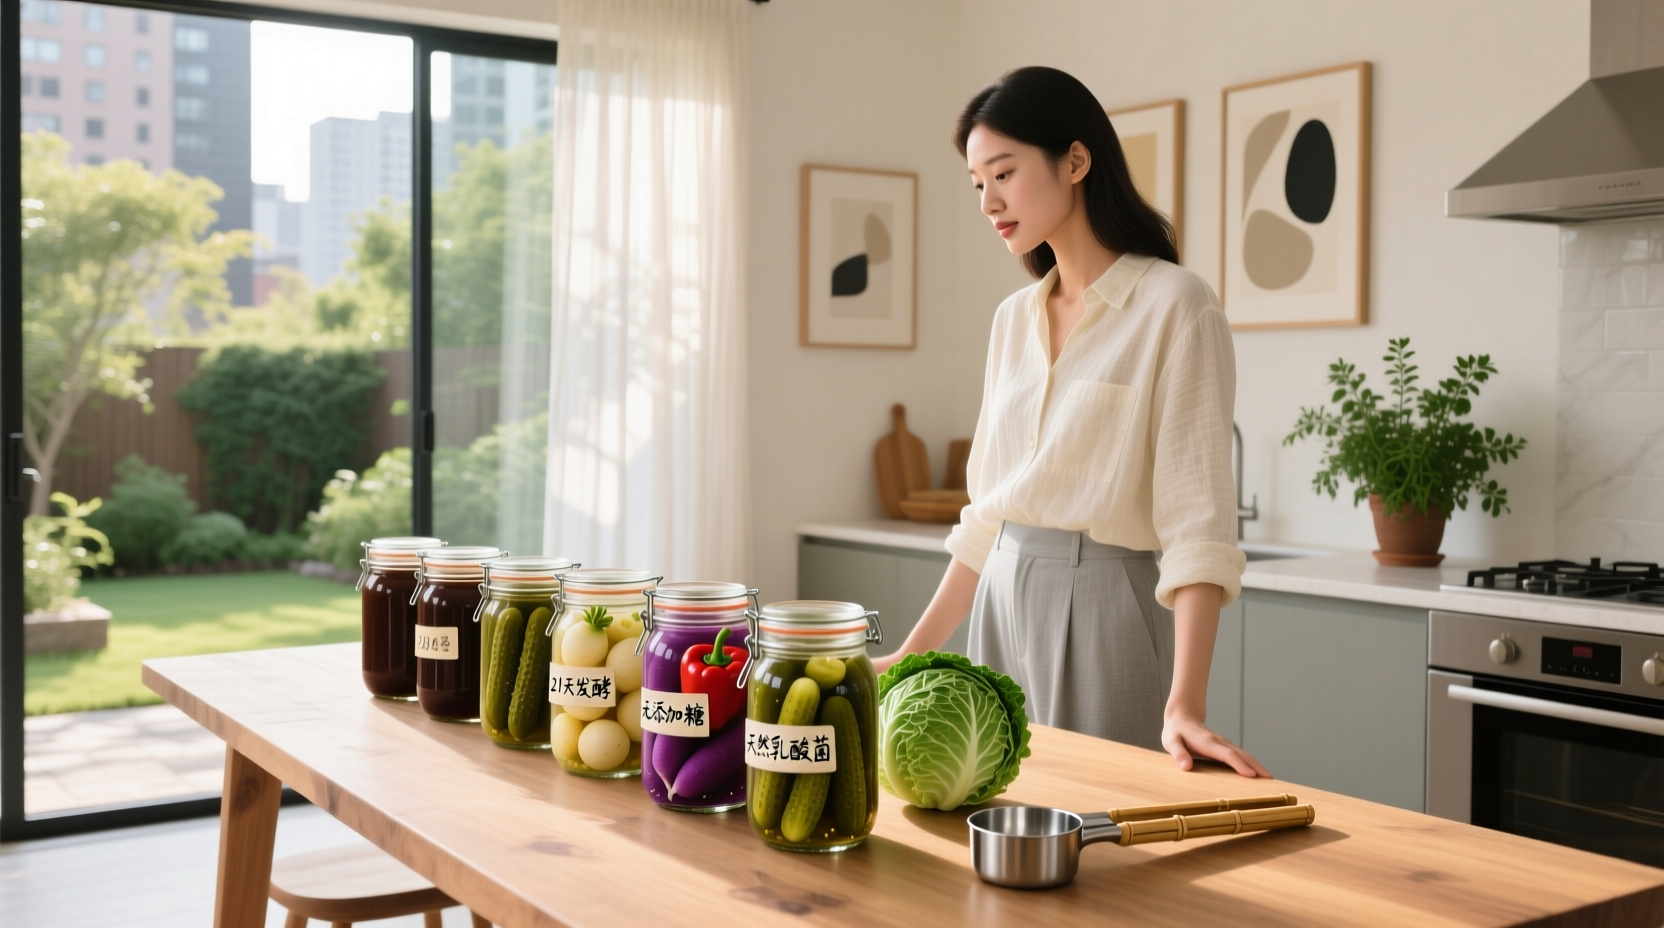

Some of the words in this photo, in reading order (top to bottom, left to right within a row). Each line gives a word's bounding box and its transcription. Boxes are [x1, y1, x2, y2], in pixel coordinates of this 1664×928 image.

[550, 675, 612, 700] 21天发酵
[642, 700, 705, 727] 无添加糖
[747, 733, 830, 763] 天然乳酸菌
